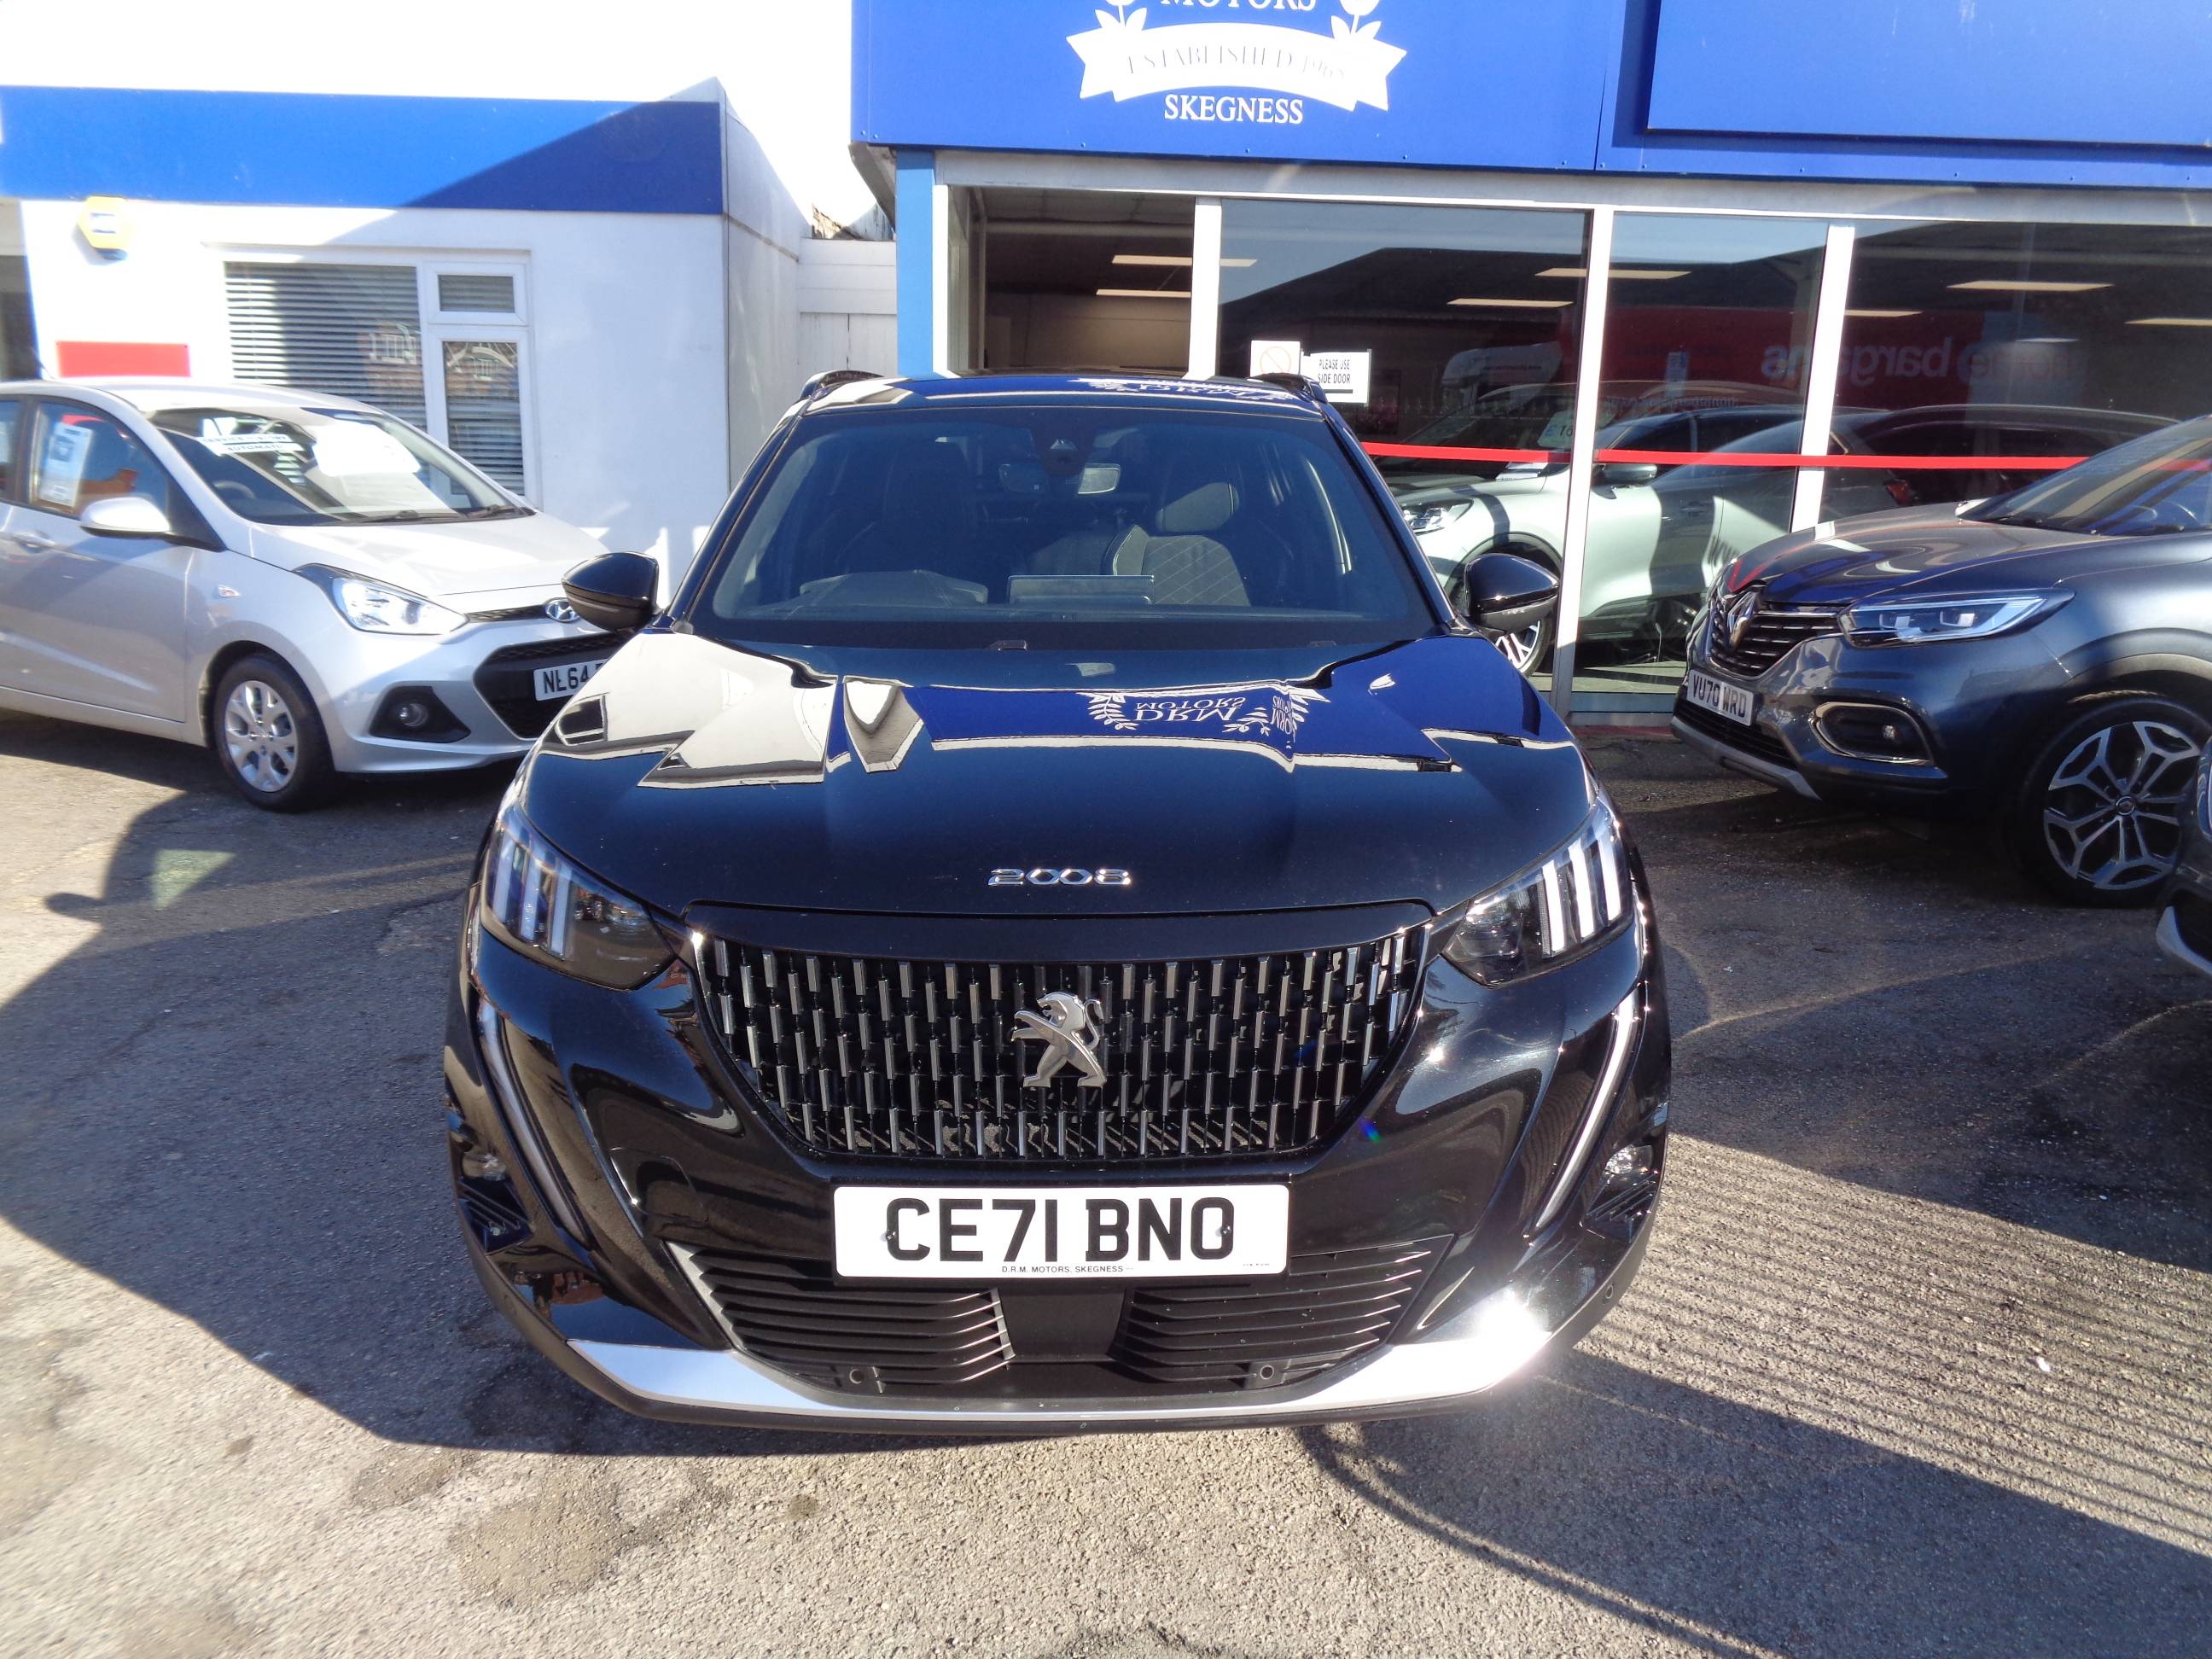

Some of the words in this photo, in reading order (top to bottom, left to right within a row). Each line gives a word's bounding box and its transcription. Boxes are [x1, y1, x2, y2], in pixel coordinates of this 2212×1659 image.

[1126, 44, 1294, 76] ESTABLISHED
[1163, 93, 1304, 125] SKEGNESS
[1317, 373, 1331, 384] SIDE
[1333, 373, 1351, 384] DOOR
[1318, 358, 1338, 370] PLEASE
[1339, 358, 1351, 370] USE
[543, 665, 590, 694] NL64
[1693, 673, 1720, 707] VU70
[1722, 686, 1747, 718] WRD
[988, 868, 1132, 886] 2008
[886, 1197, 1058, 1263] CE71
[1085, 1196, 1234, 1262] BNO
